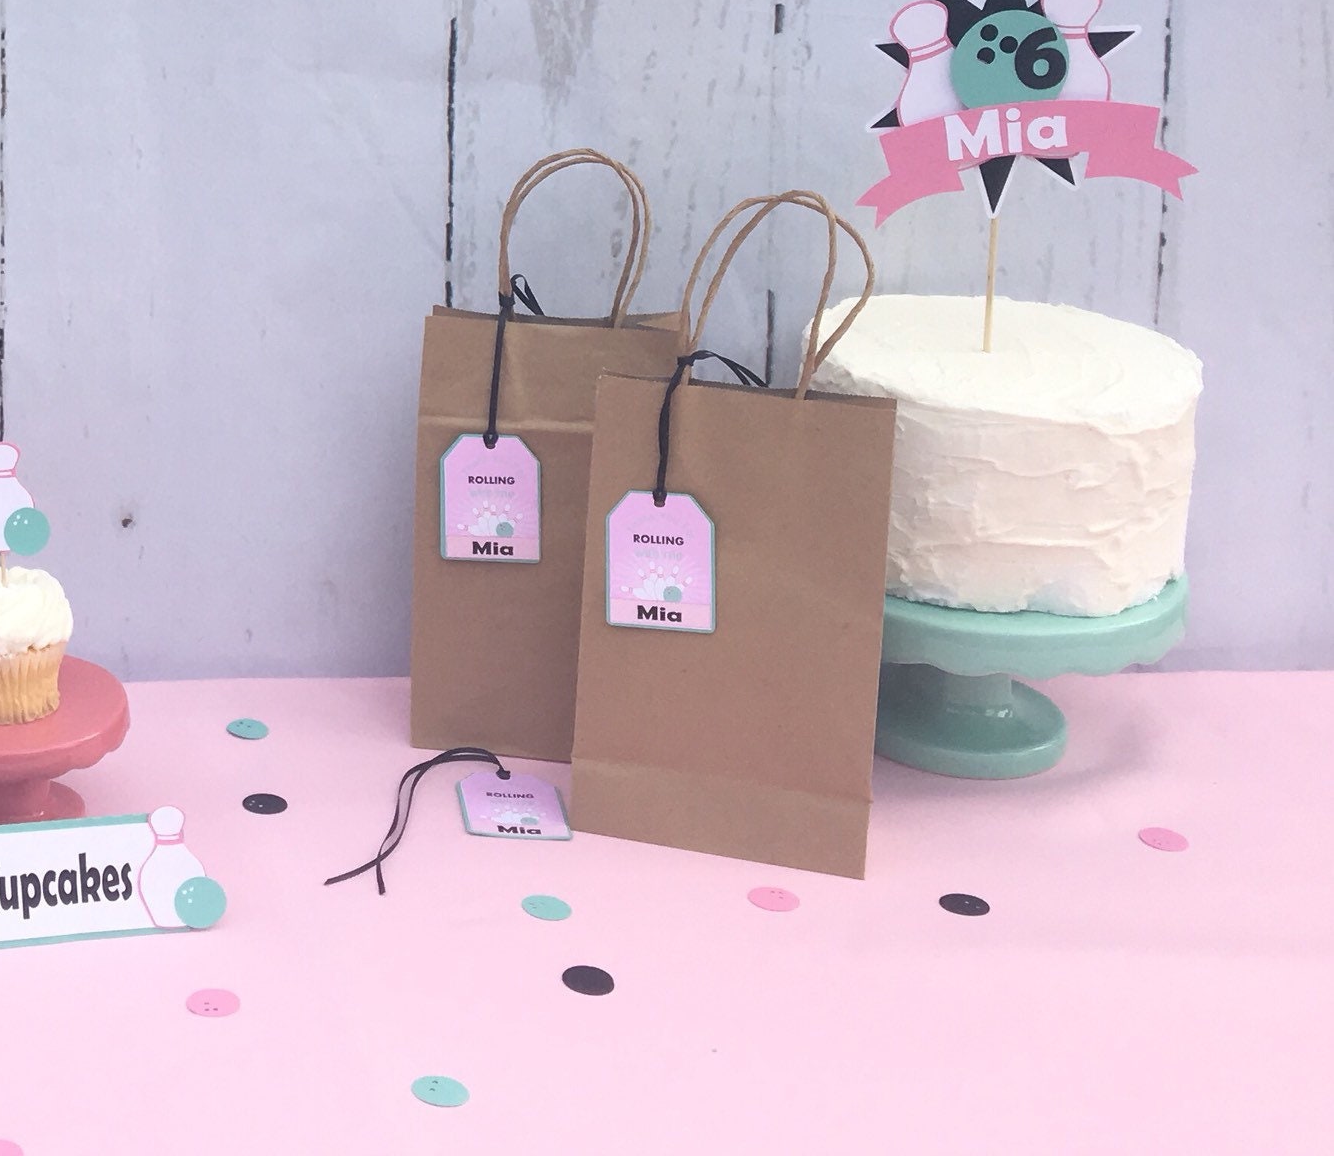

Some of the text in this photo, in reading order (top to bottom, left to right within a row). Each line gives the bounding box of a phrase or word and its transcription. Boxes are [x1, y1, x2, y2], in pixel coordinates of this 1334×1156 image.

[1014, 26, 1067, 90] 6
[943, 107, 1069, 162] Mia
[467, 475, 516, 485] ROLLING
[633, 533, 685, 546] ROLLING
[472, 540, 514, 556] Mia
[637, 604, 683, 623] Mia
[485, 791, 535, 799] ROLLING
[496, 824, 542, 835] Mia
